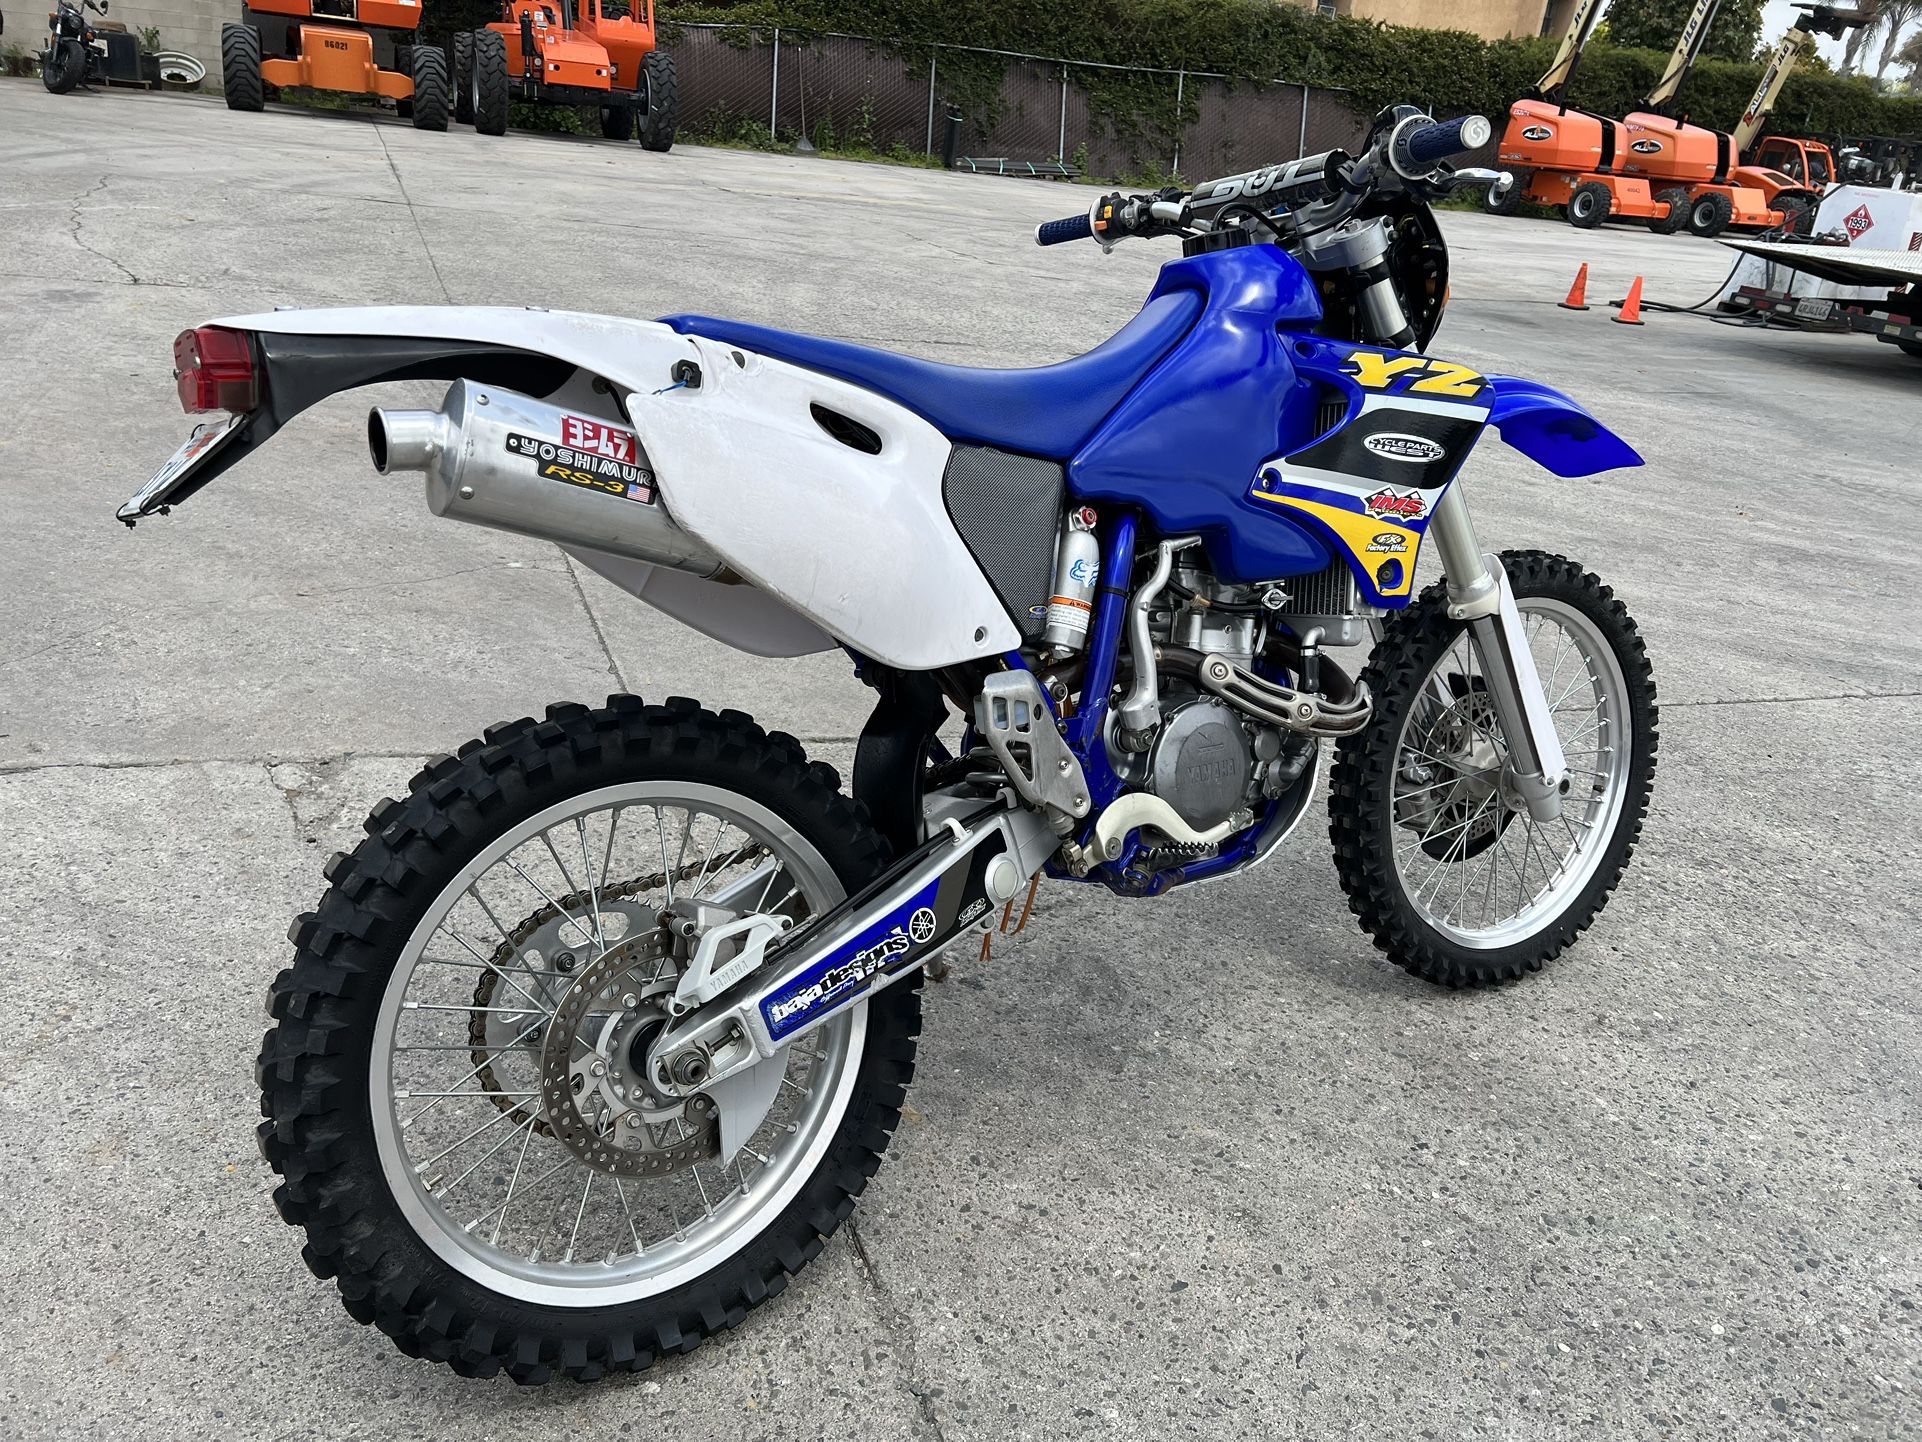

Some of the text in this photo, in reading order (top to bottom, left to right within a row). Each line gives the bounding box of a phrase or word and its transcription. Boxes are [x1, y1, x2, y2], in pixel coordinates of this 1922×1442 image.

[1684, 17, 1699, 47] JLG
[1777, 44, 1790, 66] JLG
[1850, 218, 1868, 229] 1993
[1347, 351, 1483, 398] YZ
[568, 418, 630, 460] ヨシムラ
[1369, 443, 1442, 459] WEST
[1370, 437, 1442, 453] CYCLE PARTS
[519, 437, 654, 486] YOSHIMUR
[544, 464, 626, 493] RS-3
[1368, 494, 1426, 513] IMS
[1366, 544, 1391, 554] Factory
[1187, 758, 1236, 784] YAMAHA
[709, 960, 749, 991] YAMAHA
